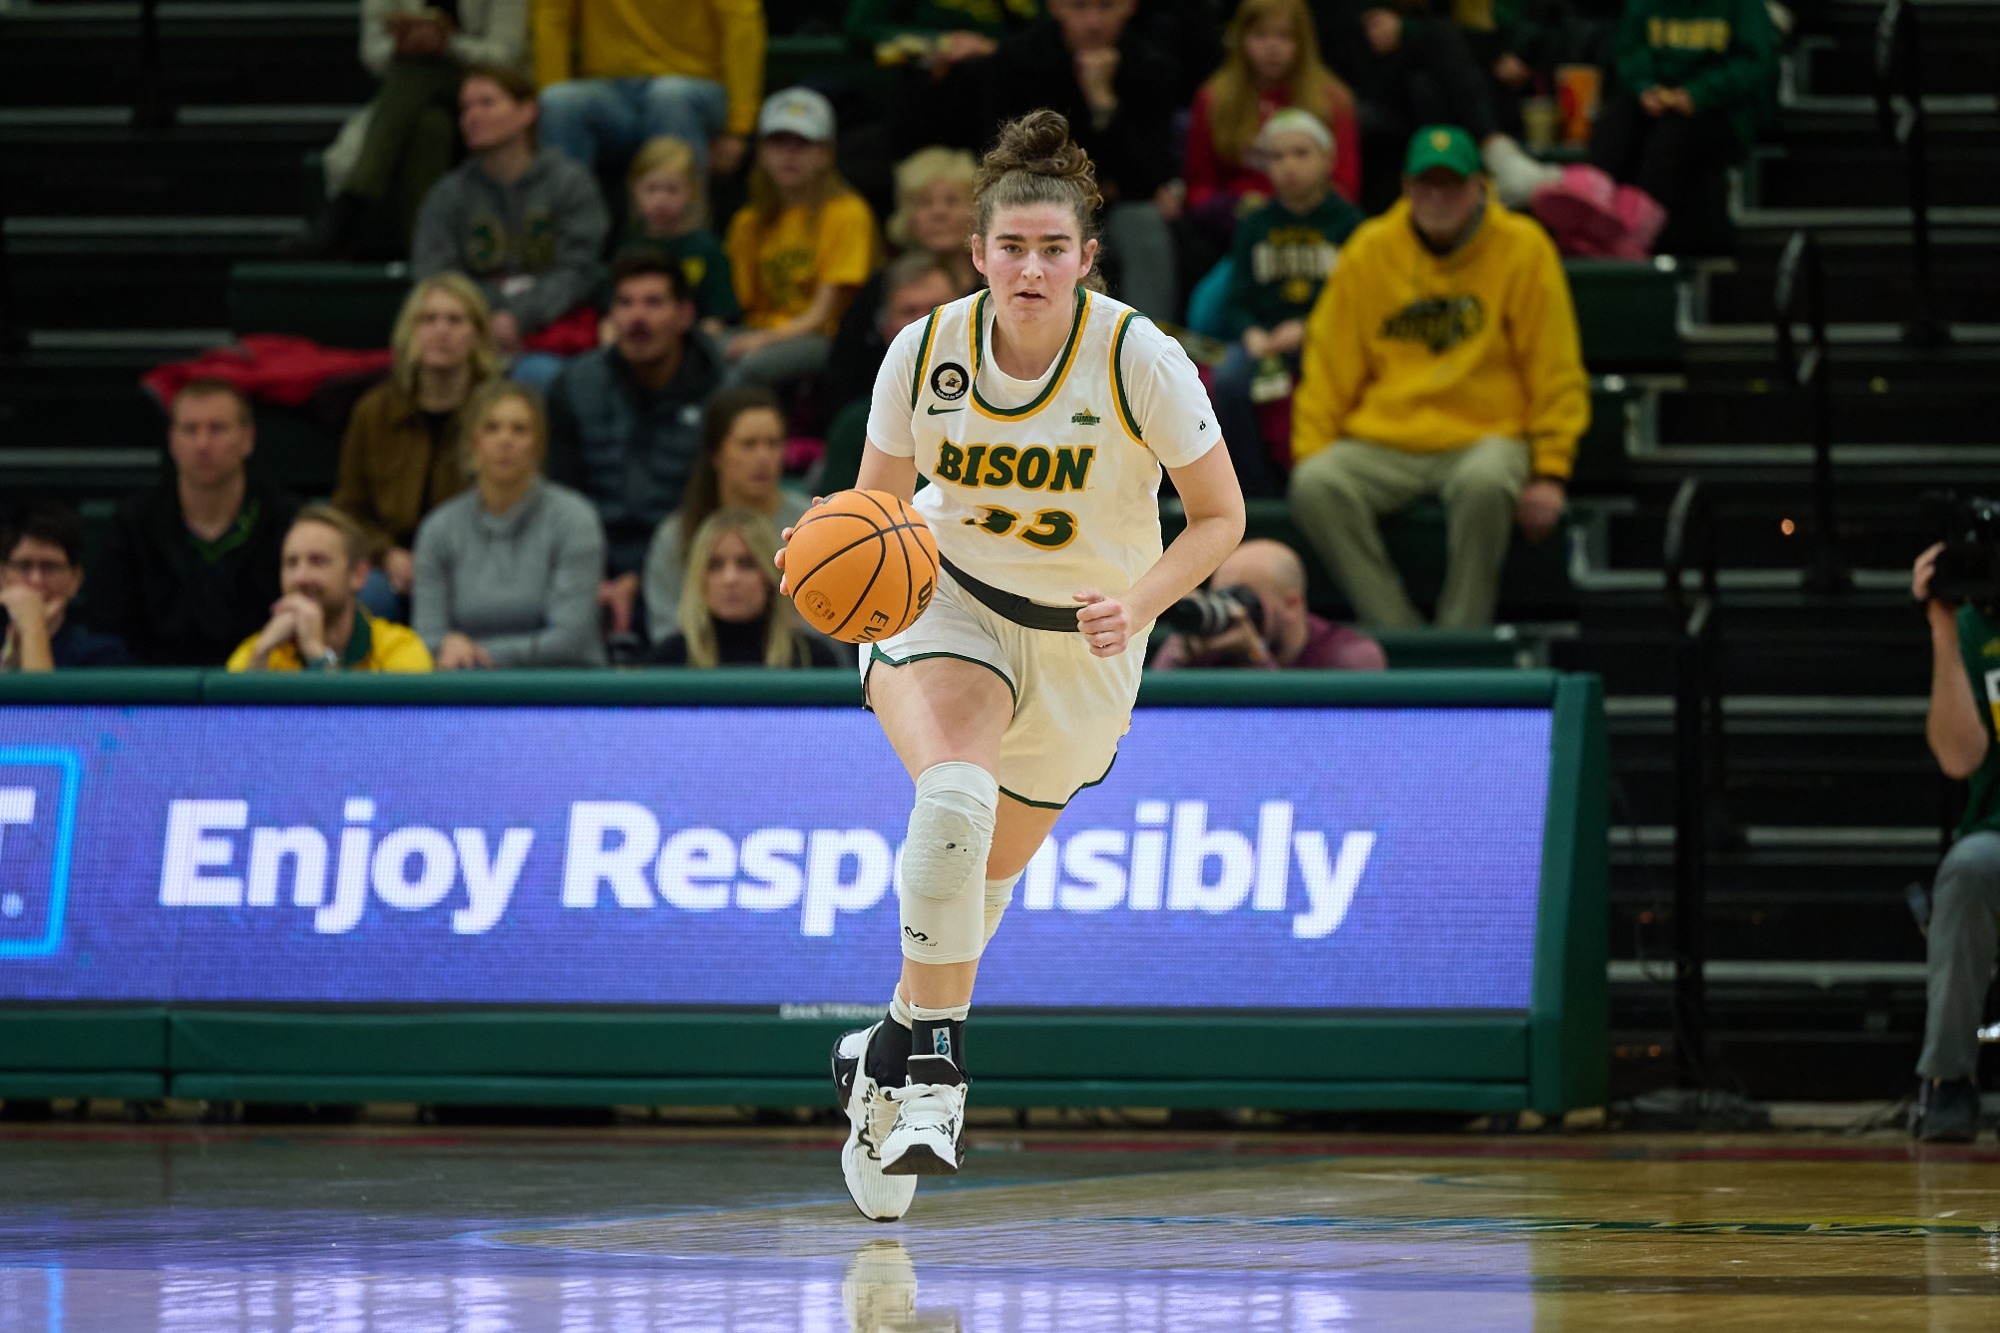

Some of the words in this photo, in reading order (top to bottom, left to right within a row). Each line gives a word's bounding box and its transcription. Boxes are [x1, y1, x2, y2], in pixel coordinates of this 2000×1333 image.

[933, 437, 1097, 493] BISON
[159, 798, 533, 934] Enjoy
[562, 799, 1376, 938] Respsibly
